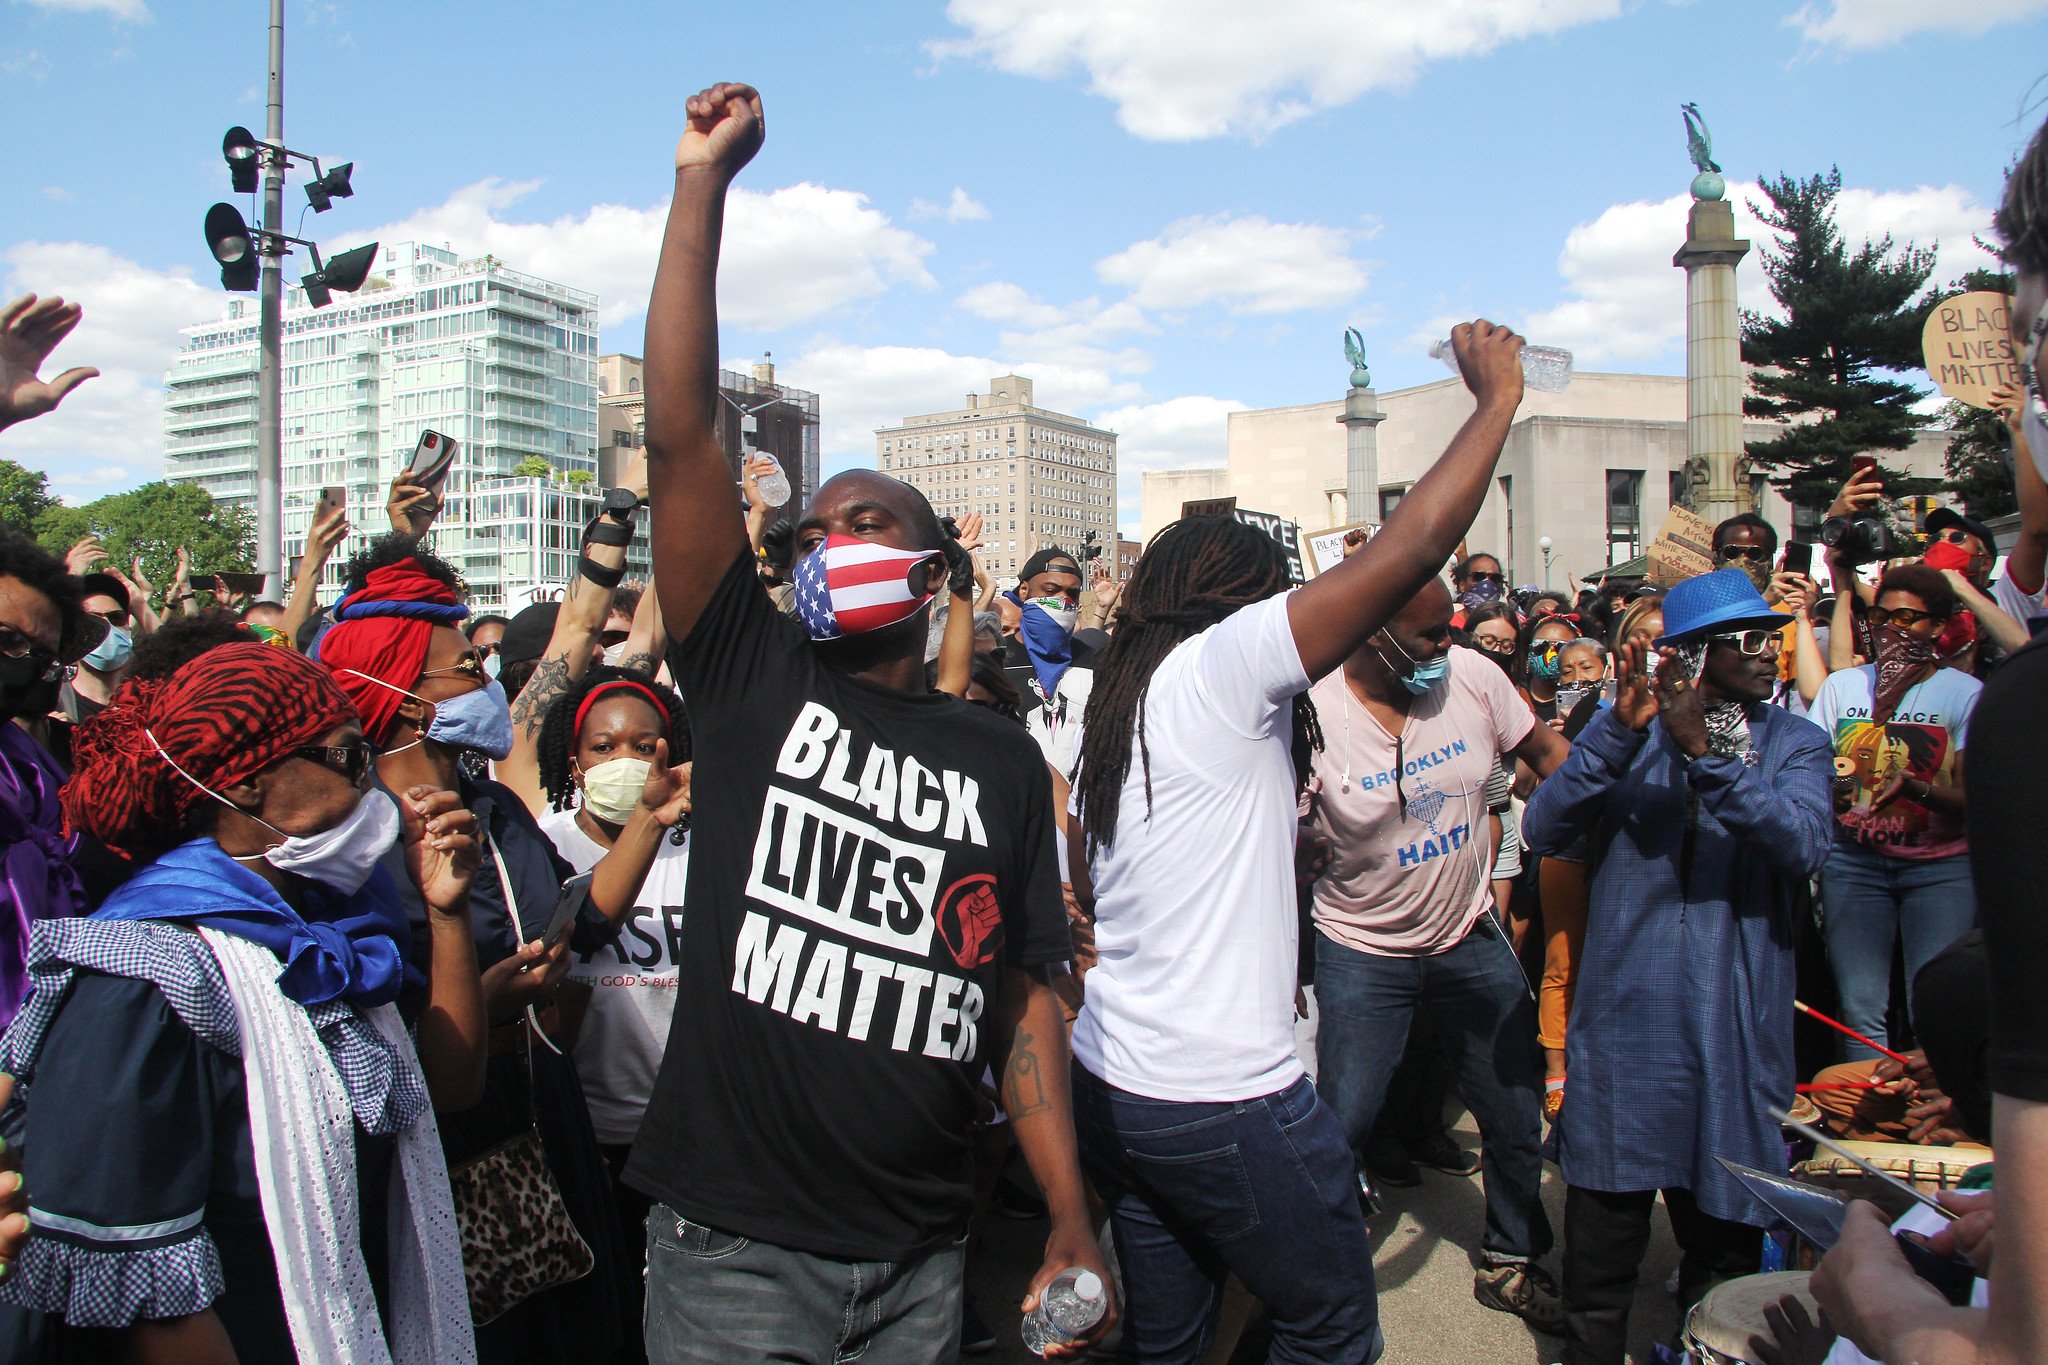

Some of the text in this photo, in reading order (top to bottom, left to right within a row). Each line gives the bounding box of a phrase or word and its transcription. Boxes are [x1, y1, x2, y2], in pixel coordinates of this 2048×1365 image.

[1941, 307, 2008, 333] BLAC
[1947, 339, 2014, 360] LIVES
[1940, 362, 2018, 386] MATTE
[1704, 525, 1713, 535] IS
[1654, 537, 1679, 554] WHITE
[1846, 706, 1870, 718] ON
[776, 701, 988, 847] BLACK
[1361, 739, 1468, 791] BROOKLYN
[761, 802, 926, 936] LIVES
[601, 974, 648, 987] GOD'S
[731, 910, 985, 1063] MATTER
